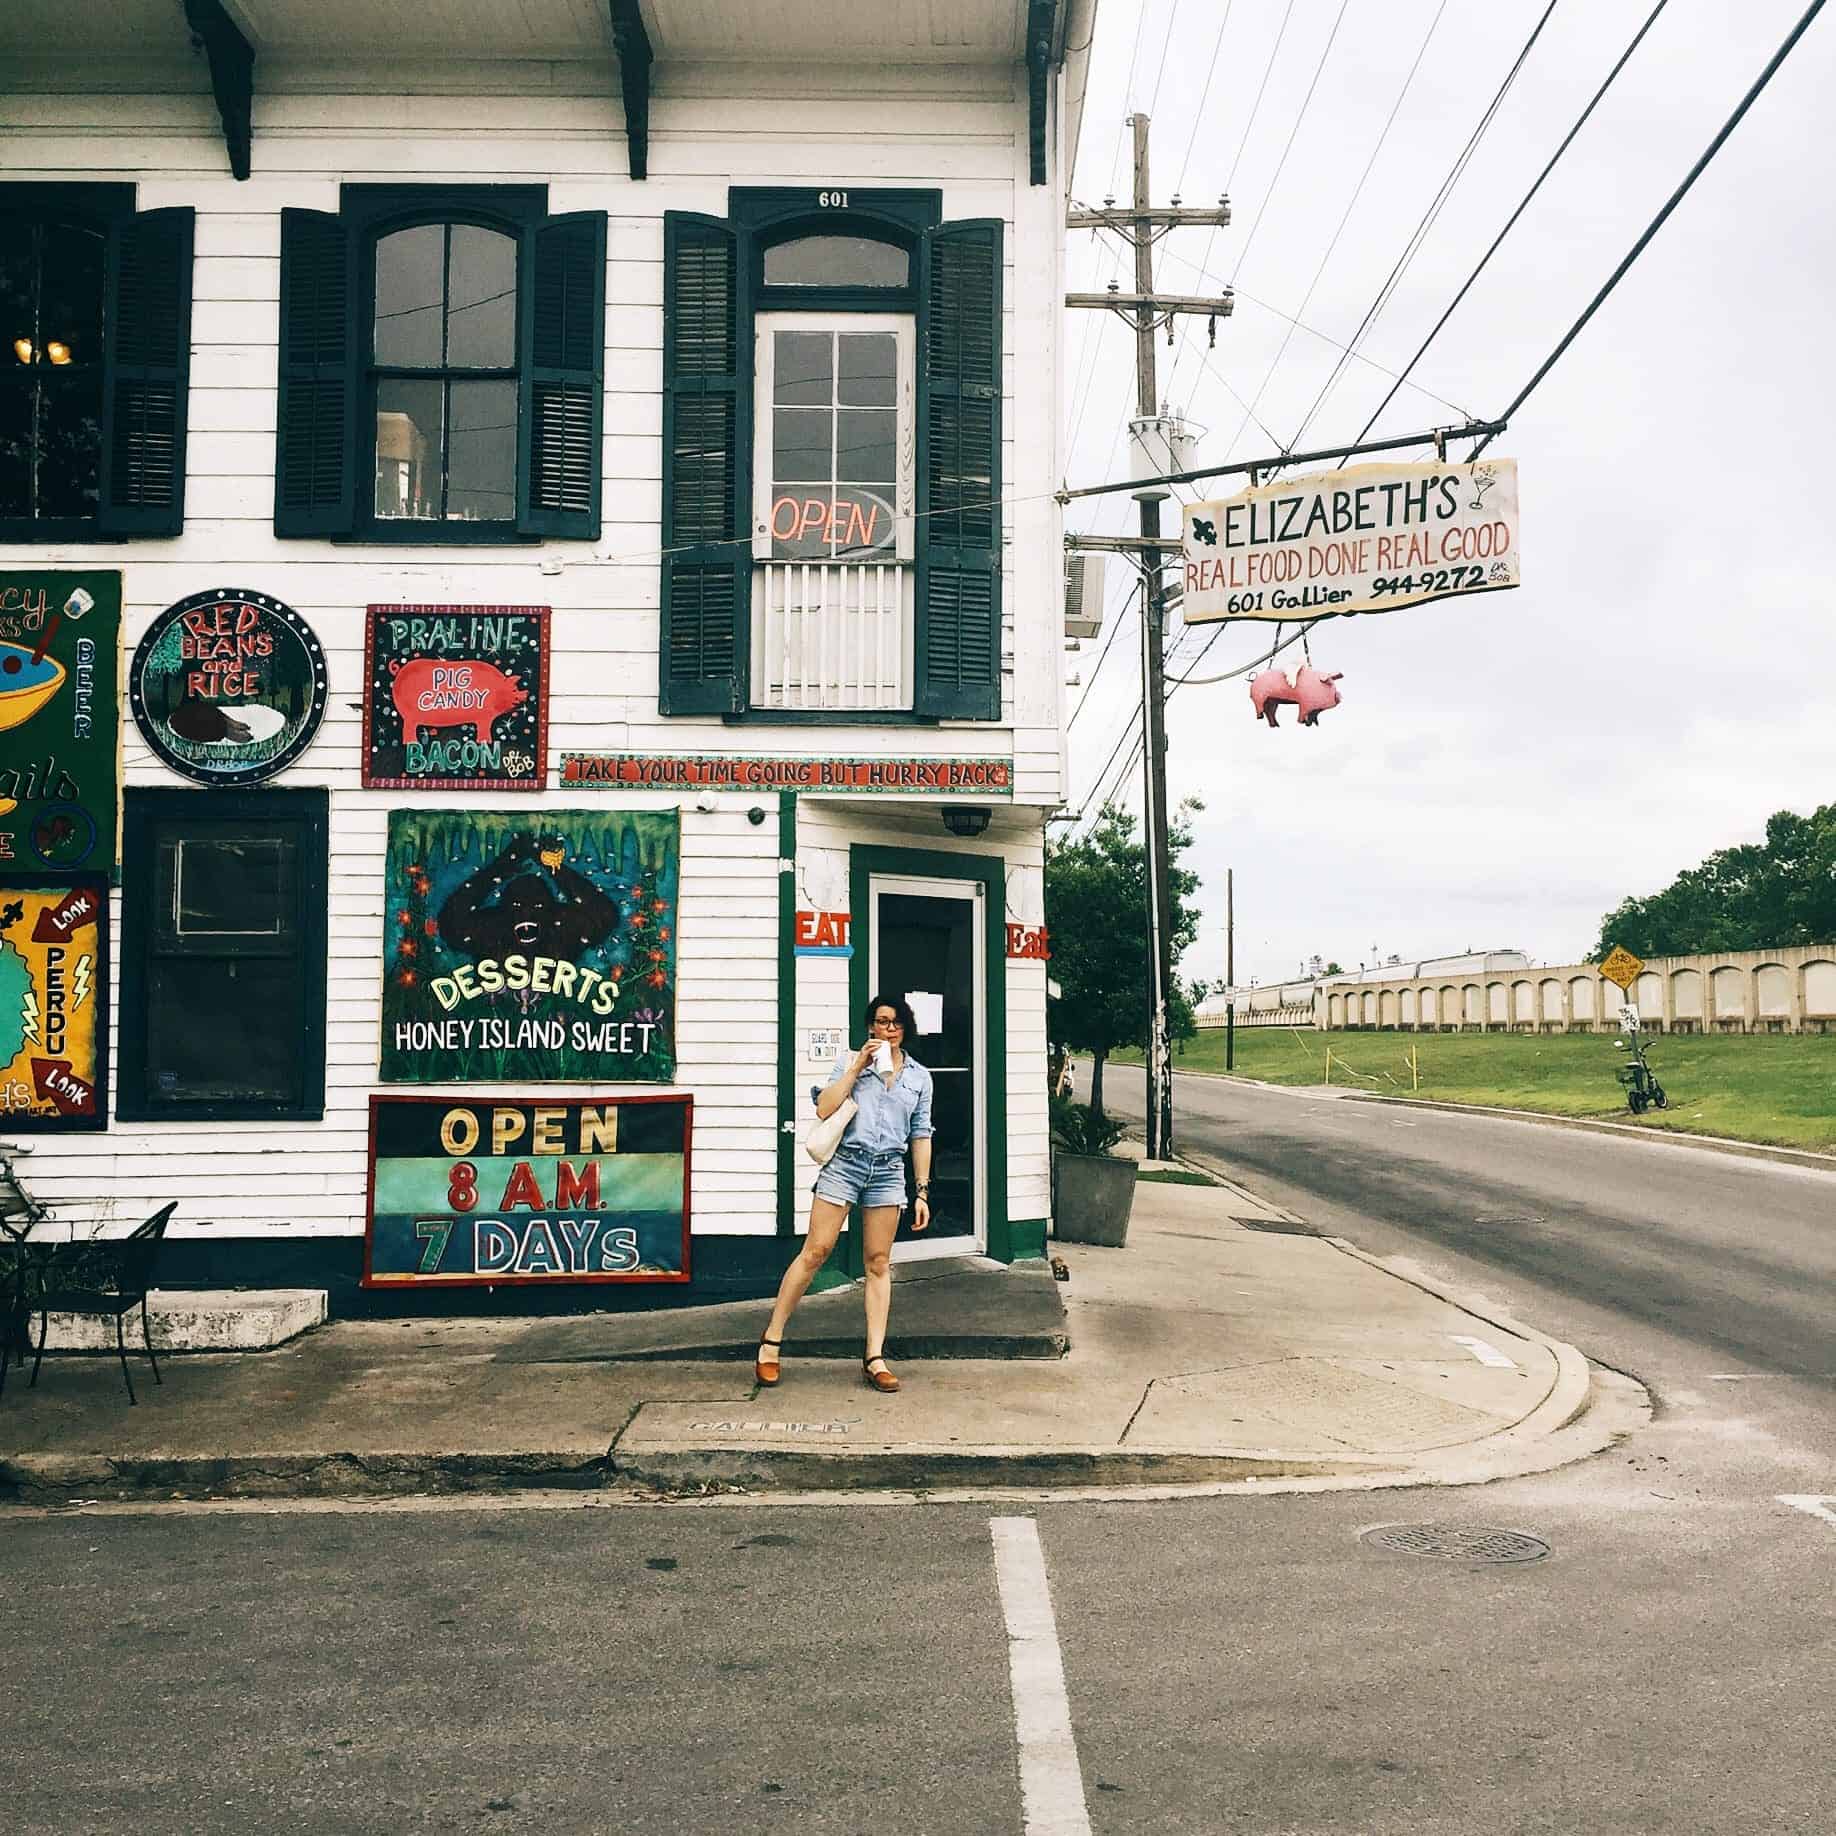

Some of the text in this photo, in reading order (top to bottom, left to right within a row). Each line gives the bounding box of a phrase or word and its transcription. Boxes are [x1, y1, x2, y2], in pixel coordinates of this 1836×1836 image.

[819, 192, 848, 207] 601
[771, 496, 877, 545] OPEN
[1225, 475, 1460, 548] ELIZABETH'S
[1186, 521, 1510, 592] REAL FOOD DONE REAL GOOD
[1228, 592, 1264, 614] 601
[1369, 565, 1487, 598] 944-9272
[183, 603, 261, 639] RED
[388, 616, 526, 650] PRALINE
[181, 633, 273, 659] BEANS
[202, 657, 243, 673] and
[433, 668, 472, 690] PIG
[74, 638, 95, 739] BEER
[188, 672, 261, 698] RICE
[418, 688, 490, 711] CANDY
[405, 740, 500, 773] BACON
[575, 759, 998, 785] TAKE YOUR TIME GOING BUT HURRY BACK
[795, 911, 852, 946] EAT
[1006, 923, 1052, 960] Eat
[46, 947, 65, 1055] PERDU
[430, 954, 620, 1015] DESSERTS
[395, 1018, 655, 1053] HONEY ISLAND SWEET
[440, 1104, 618, 1156] OPEN
[447, 1160, 608, 1212] 8 A.M.
[415, 1218, 454, 1273] 7
